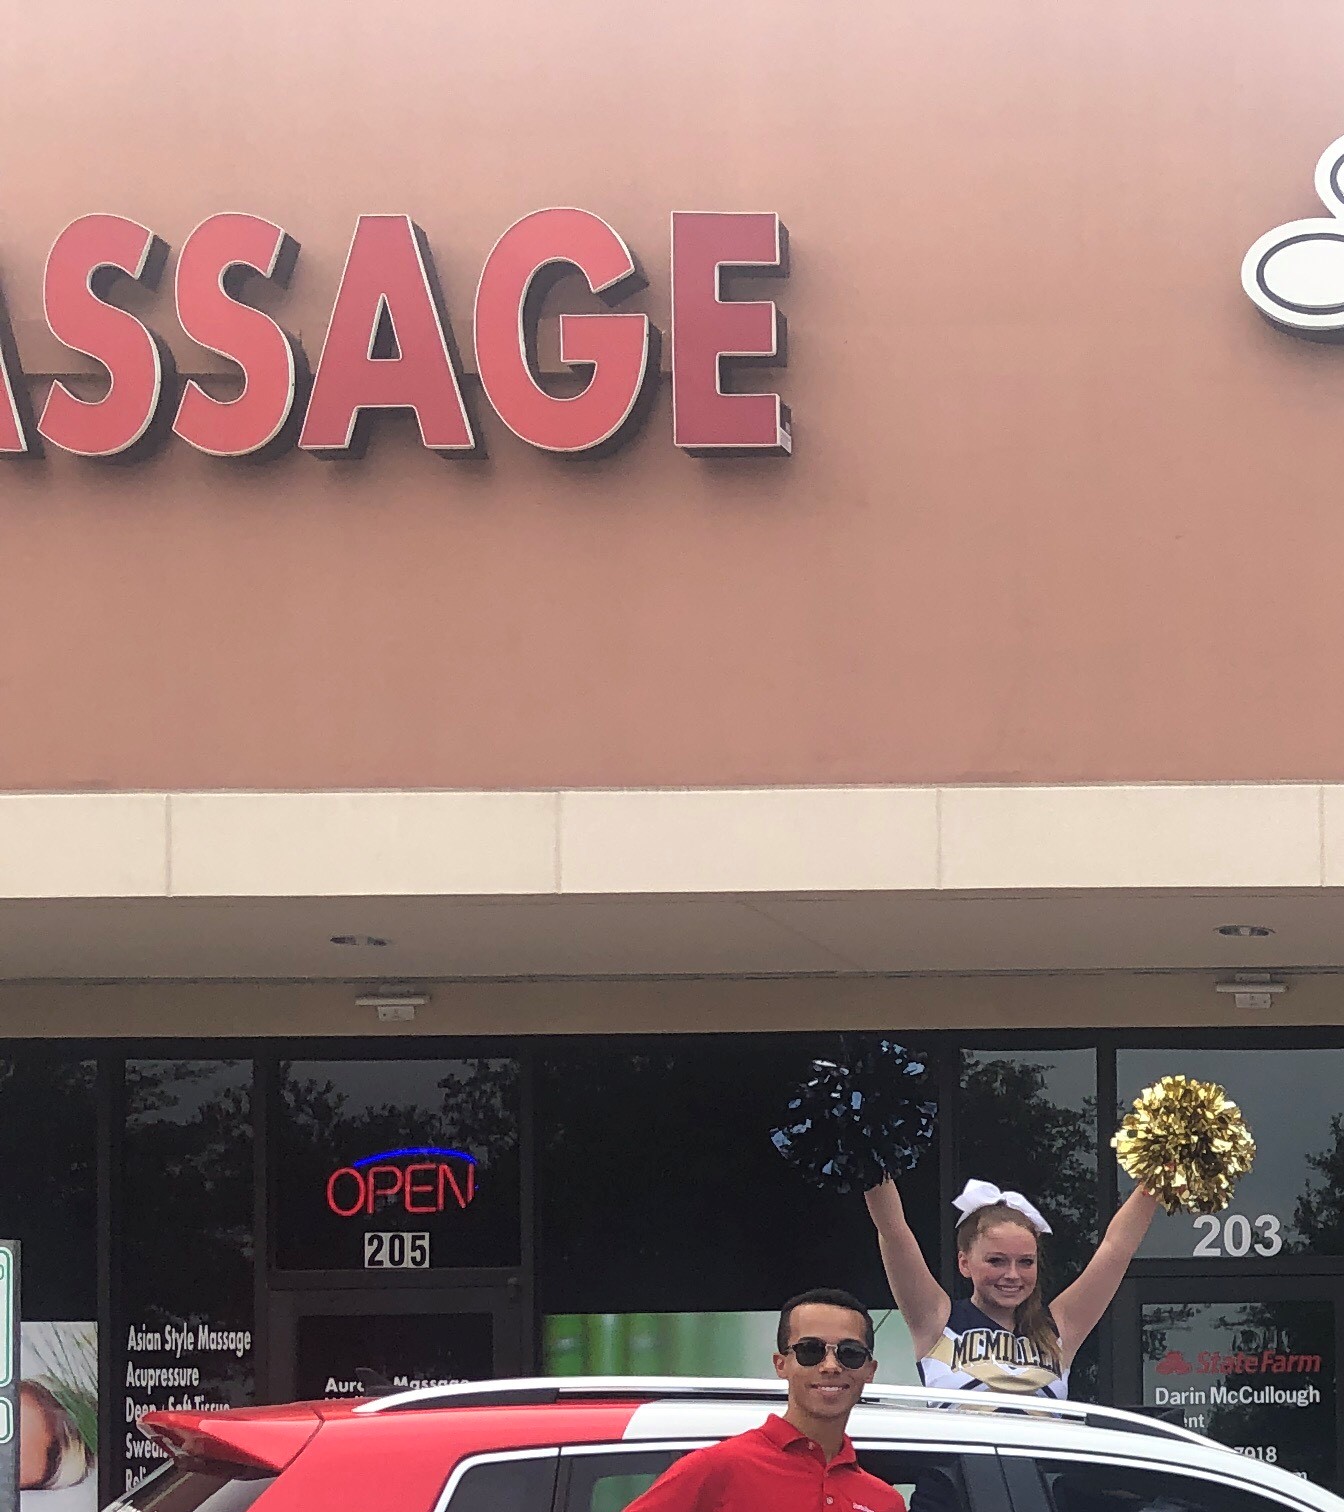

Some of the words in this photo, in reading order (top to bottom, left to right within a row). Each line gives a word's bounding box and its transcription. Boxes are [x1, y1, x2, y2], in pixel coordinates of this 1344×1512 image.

[0, 207, 784, 455] SSAGE
[327, 1162, 475, 1217] OPEN
[367, 1234, 427, 1267] 205
[1192, 1213, 1283, 1258] 203
[127, 1323, 161, 1351] Asian
[164, 1322, 194, 1358] Style
[197, 1324, 251, 1358] Massage
[950, 1328, 1062, 1381] MCMILL
[126, 1360, 199, 1395] Acupressure
[393, 1375, 469, 1390] Massa
[1155, 1387, 1206, 1405] Darin
[1210, 1385, 1321, 1407] McCullough
